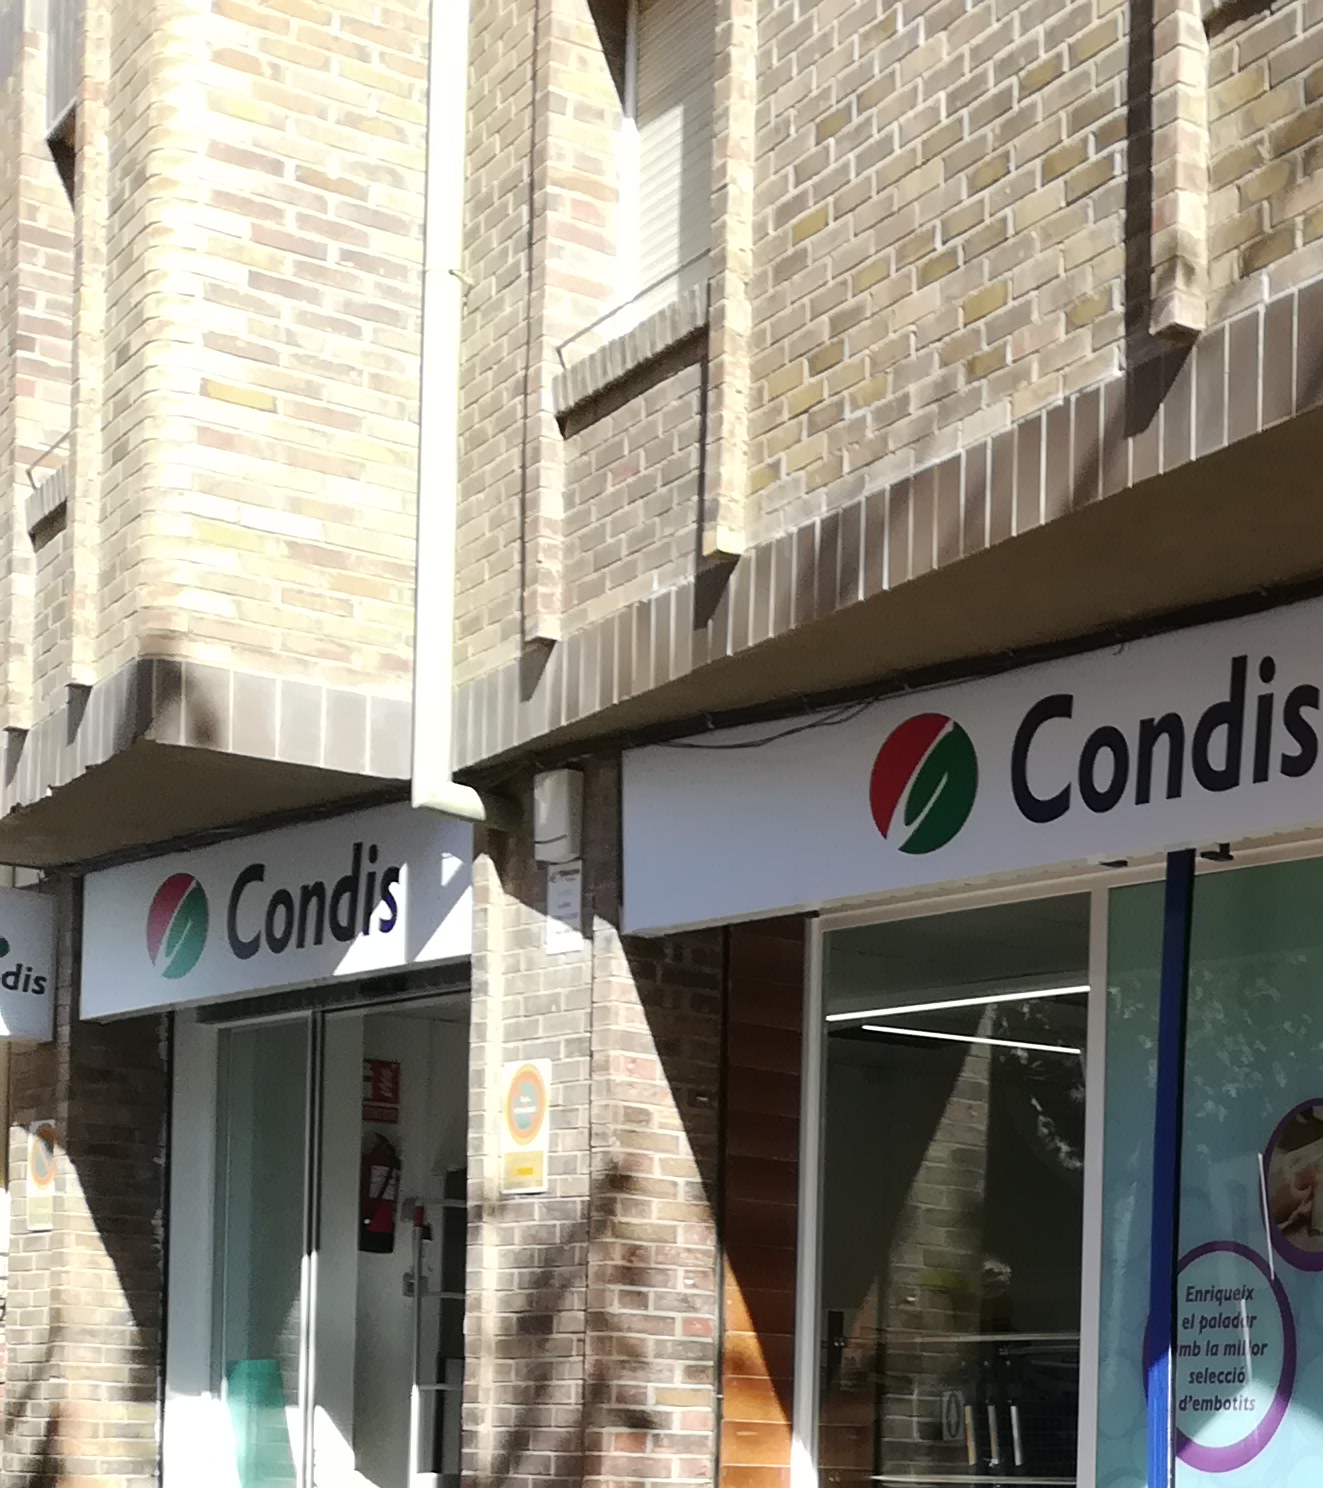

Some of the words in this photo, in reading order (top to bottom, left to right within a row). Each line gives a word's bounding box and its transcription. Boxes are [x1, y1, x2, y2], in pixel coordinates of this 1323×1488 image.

[1010, 653, 1320, 824] Condis
[226, 841, 401, 961] Condis
[0, 962, 48, 995] dis
[1185, 1285, 1254, 1307] Enriqueix
[1182, 1313, 1195, 1330] el
[1199, 1311, 1258, 1335] paladar
[1177, 1340, 1201, 1357] mb
[1205, 1340, 1219, 1357] la
[1188, 1365, 1246, 1384] selecció
